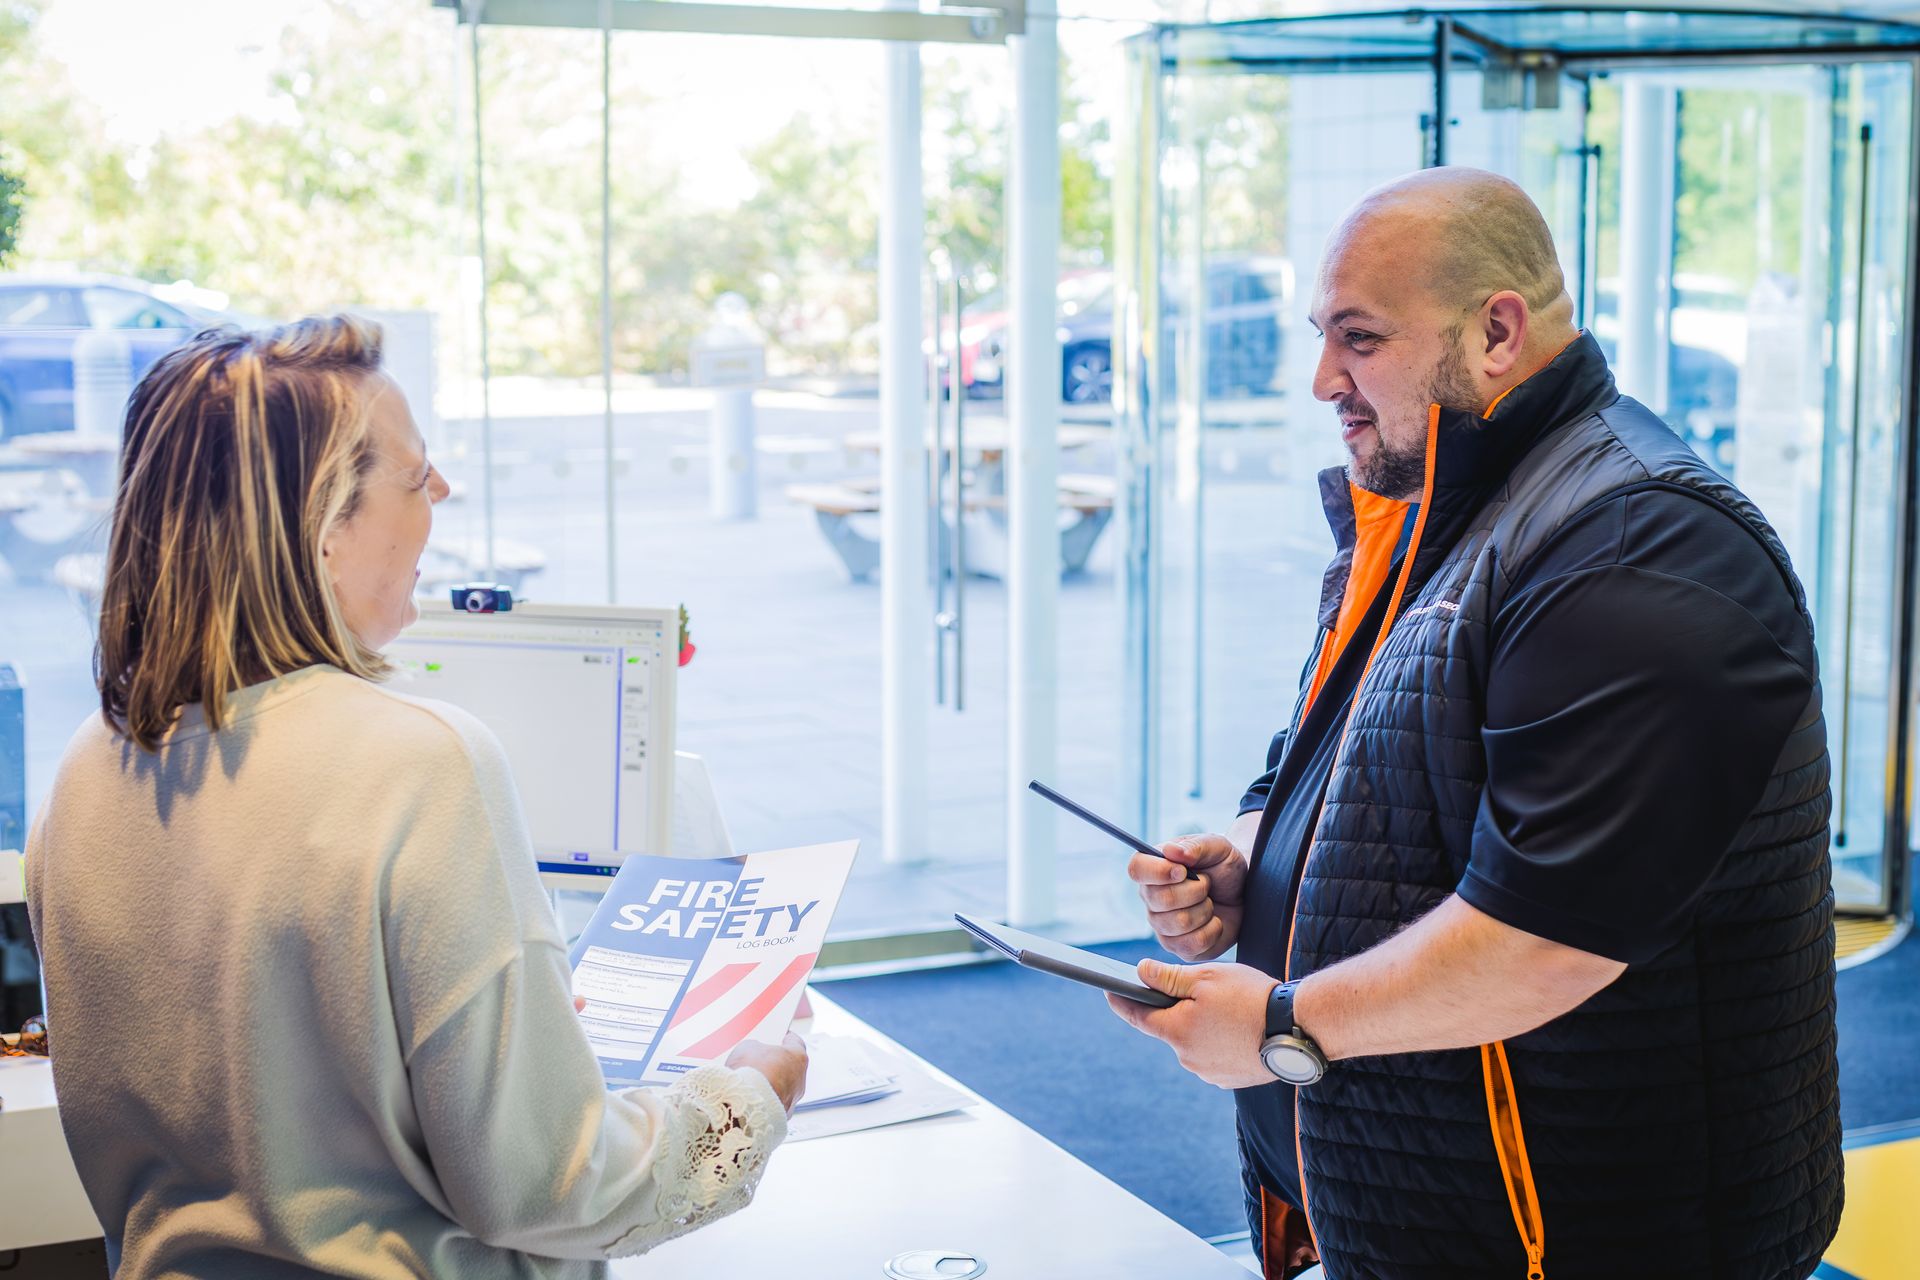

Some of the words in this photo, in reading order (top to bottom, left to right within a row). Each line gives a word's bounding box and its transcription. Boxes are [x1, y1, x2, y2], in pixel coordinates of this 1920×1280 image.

[646, 877, 765, 909] FIRE
[610, 900, 820, 939] SAFETY
[736, 940, 761, 950] LOG
[762, 934, 797, 948] BOOK
